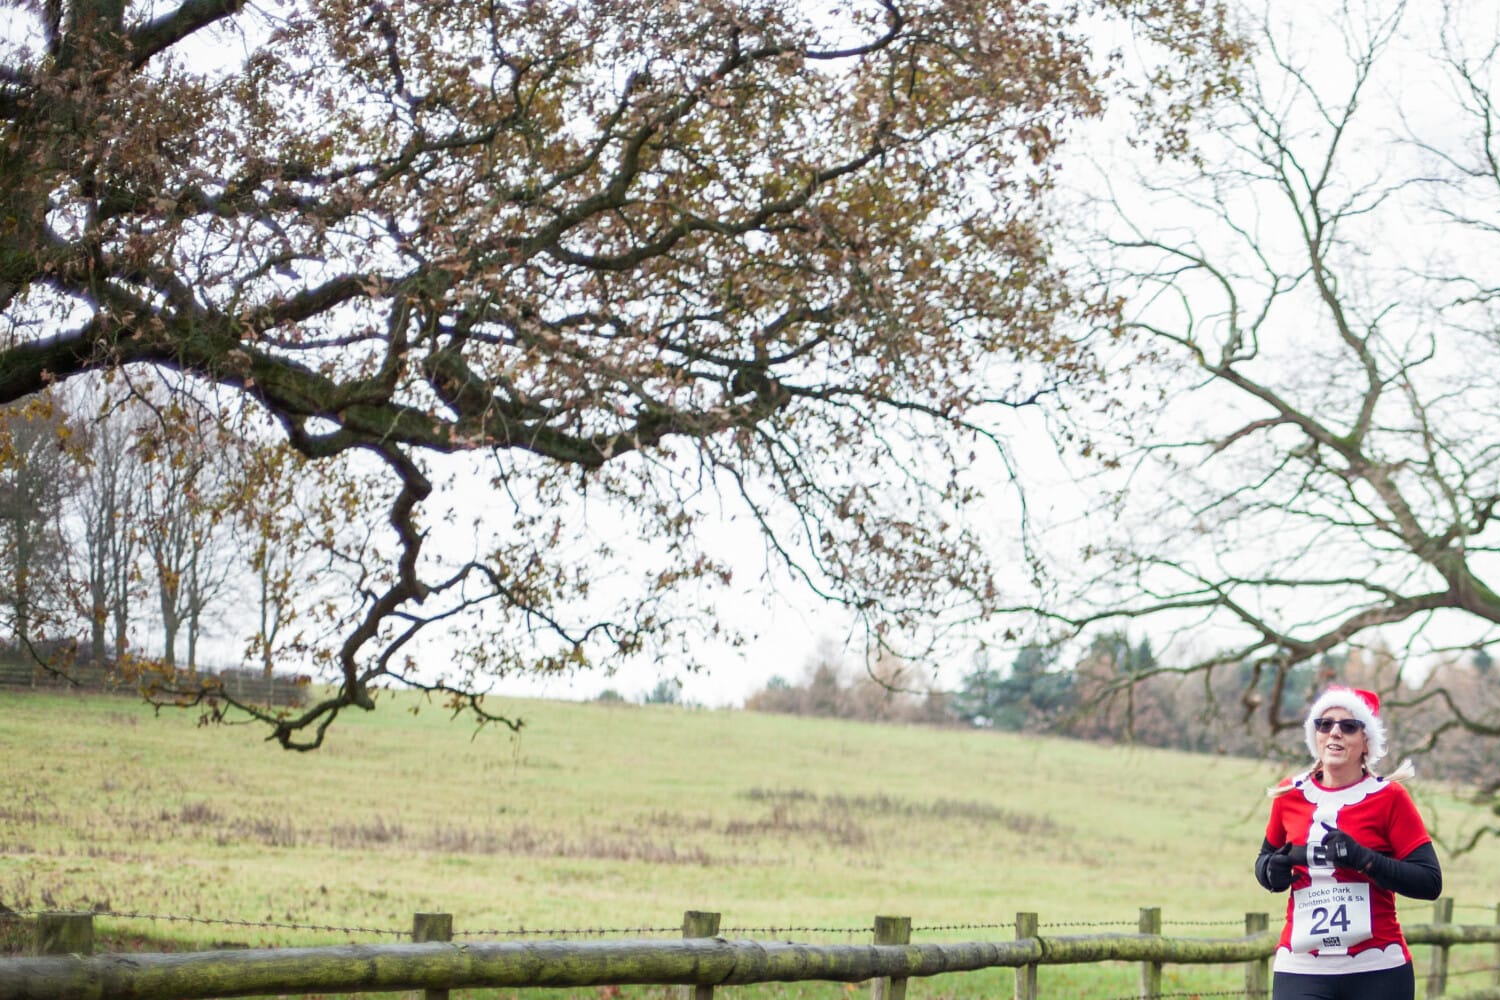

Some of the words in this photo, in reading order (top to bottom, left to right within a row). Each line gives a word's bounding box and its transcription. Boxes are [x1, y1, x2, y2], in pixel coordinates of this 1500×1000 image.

[1309, 888, 1330, 898] Locko
[1299, 898, 1331, 909] Christmas
[1310, 904, 1351, 935] 24
